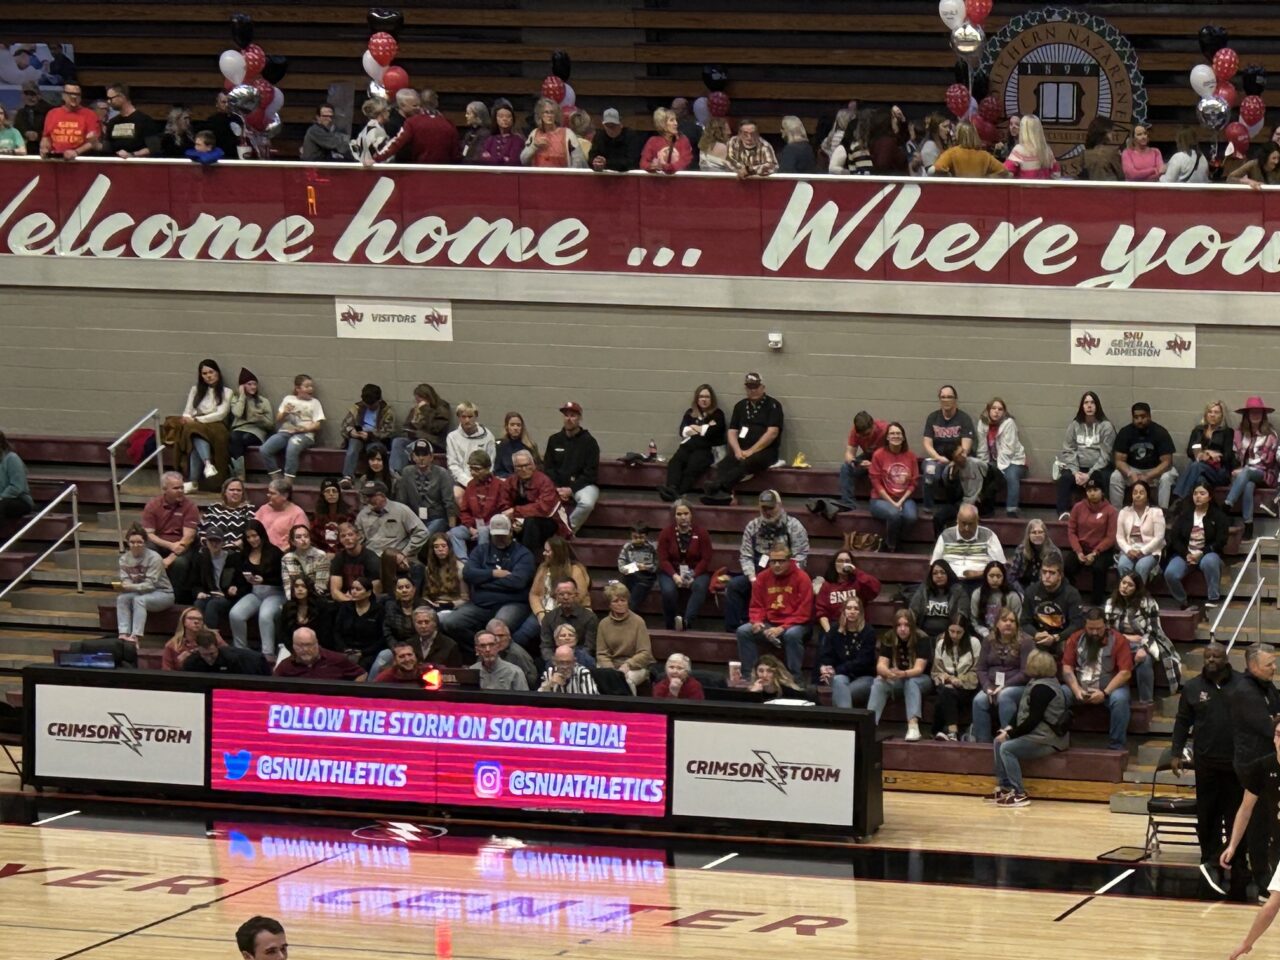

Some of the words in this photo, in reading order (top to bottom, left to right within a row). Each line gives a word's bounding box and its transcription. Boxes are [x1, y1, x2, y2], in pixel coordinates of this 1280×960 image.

[0, 173, 314, 263] elcome
[333, 176, 591, 267] home
[761, 181, 1080, 275] Where
[371, 313, 417, 323] VISITORS
[1110, 339, 1155, 349] GENERAL
[1123, 331, 1144, 340] SNU
[1105, 347, 1161, 357] ADMISSION
[47, 721, 122, 740] CRIMSON
[133, 726, 193, 744] STORM
[268, 704, 345, 732] FOLLOW
[348, 708, 387, 735] THE
[388, 711, 456, 739] STORM
[457, 715, 487, 740] ON
[488, 717, 556, 744] SOCIAL
[559, 721, 628, 748] MEDIA!
[256, 755, 408, 788] @SNUATHLETICS
[686, 759, 766, 778] CRIMSON
[777, 765, 841, 783] STORM
[508, 769, 665, 803] @SNUATHLETICS
[311, 886, 849, 937] CENTER
